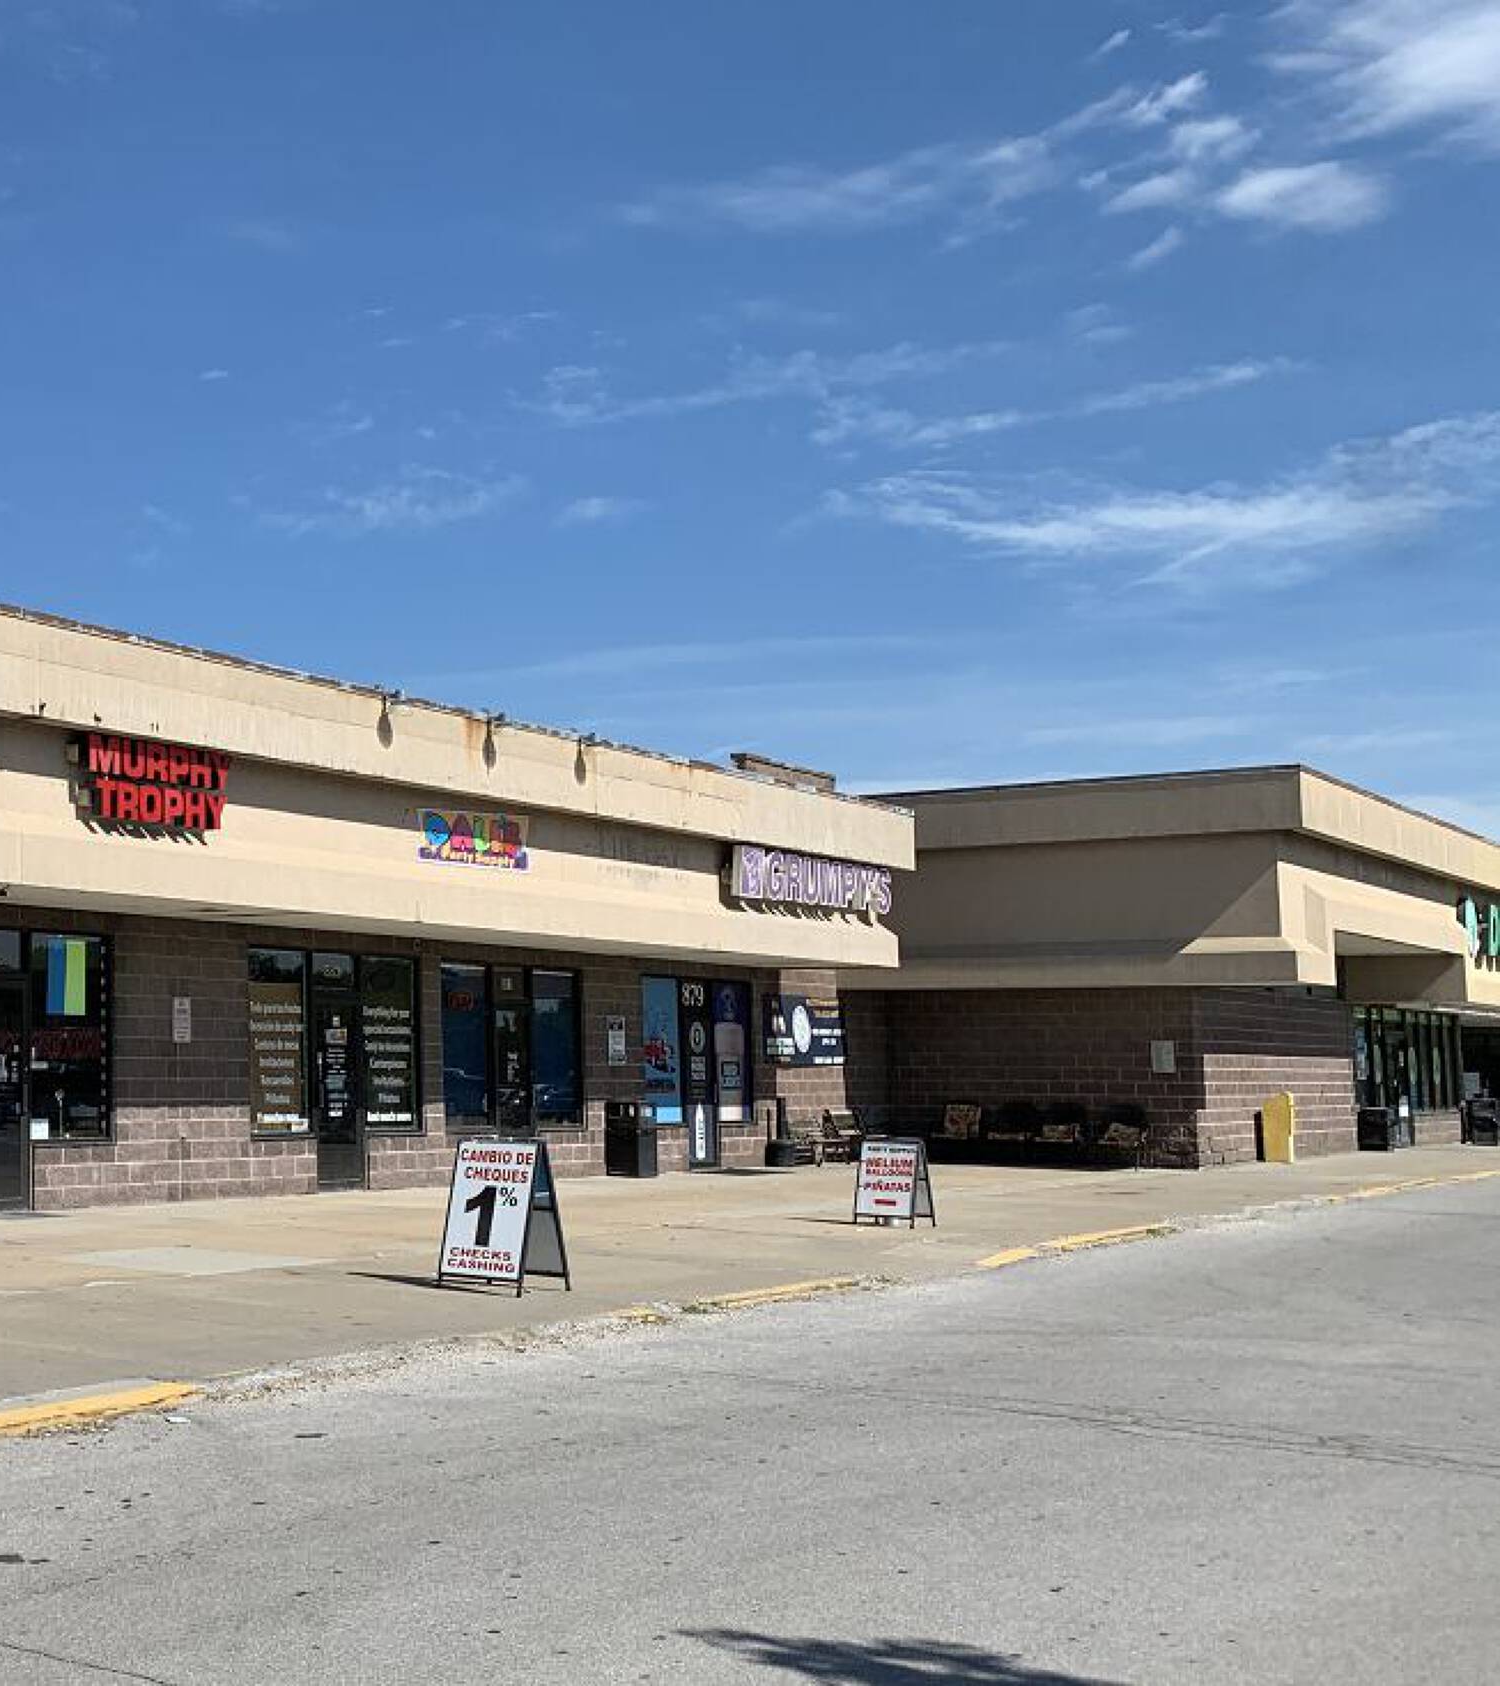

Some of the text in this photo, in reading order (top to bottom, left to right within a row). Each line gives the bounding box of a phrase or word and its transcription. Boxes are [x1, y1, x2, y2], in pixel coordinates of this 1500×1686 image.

[88, 733, 230, 791] MURPHY
[96, 777, 228, 830] TROPHY
[682, 983, 704, 1007] 879
[461, 1148, 534, 1166] CAMBIO DE
[464, 1166, 529, 1184] CHEQUES
[449, 1246, 512, 1262] CHECKS
[447, 1258, 516, 1273] CASHING
